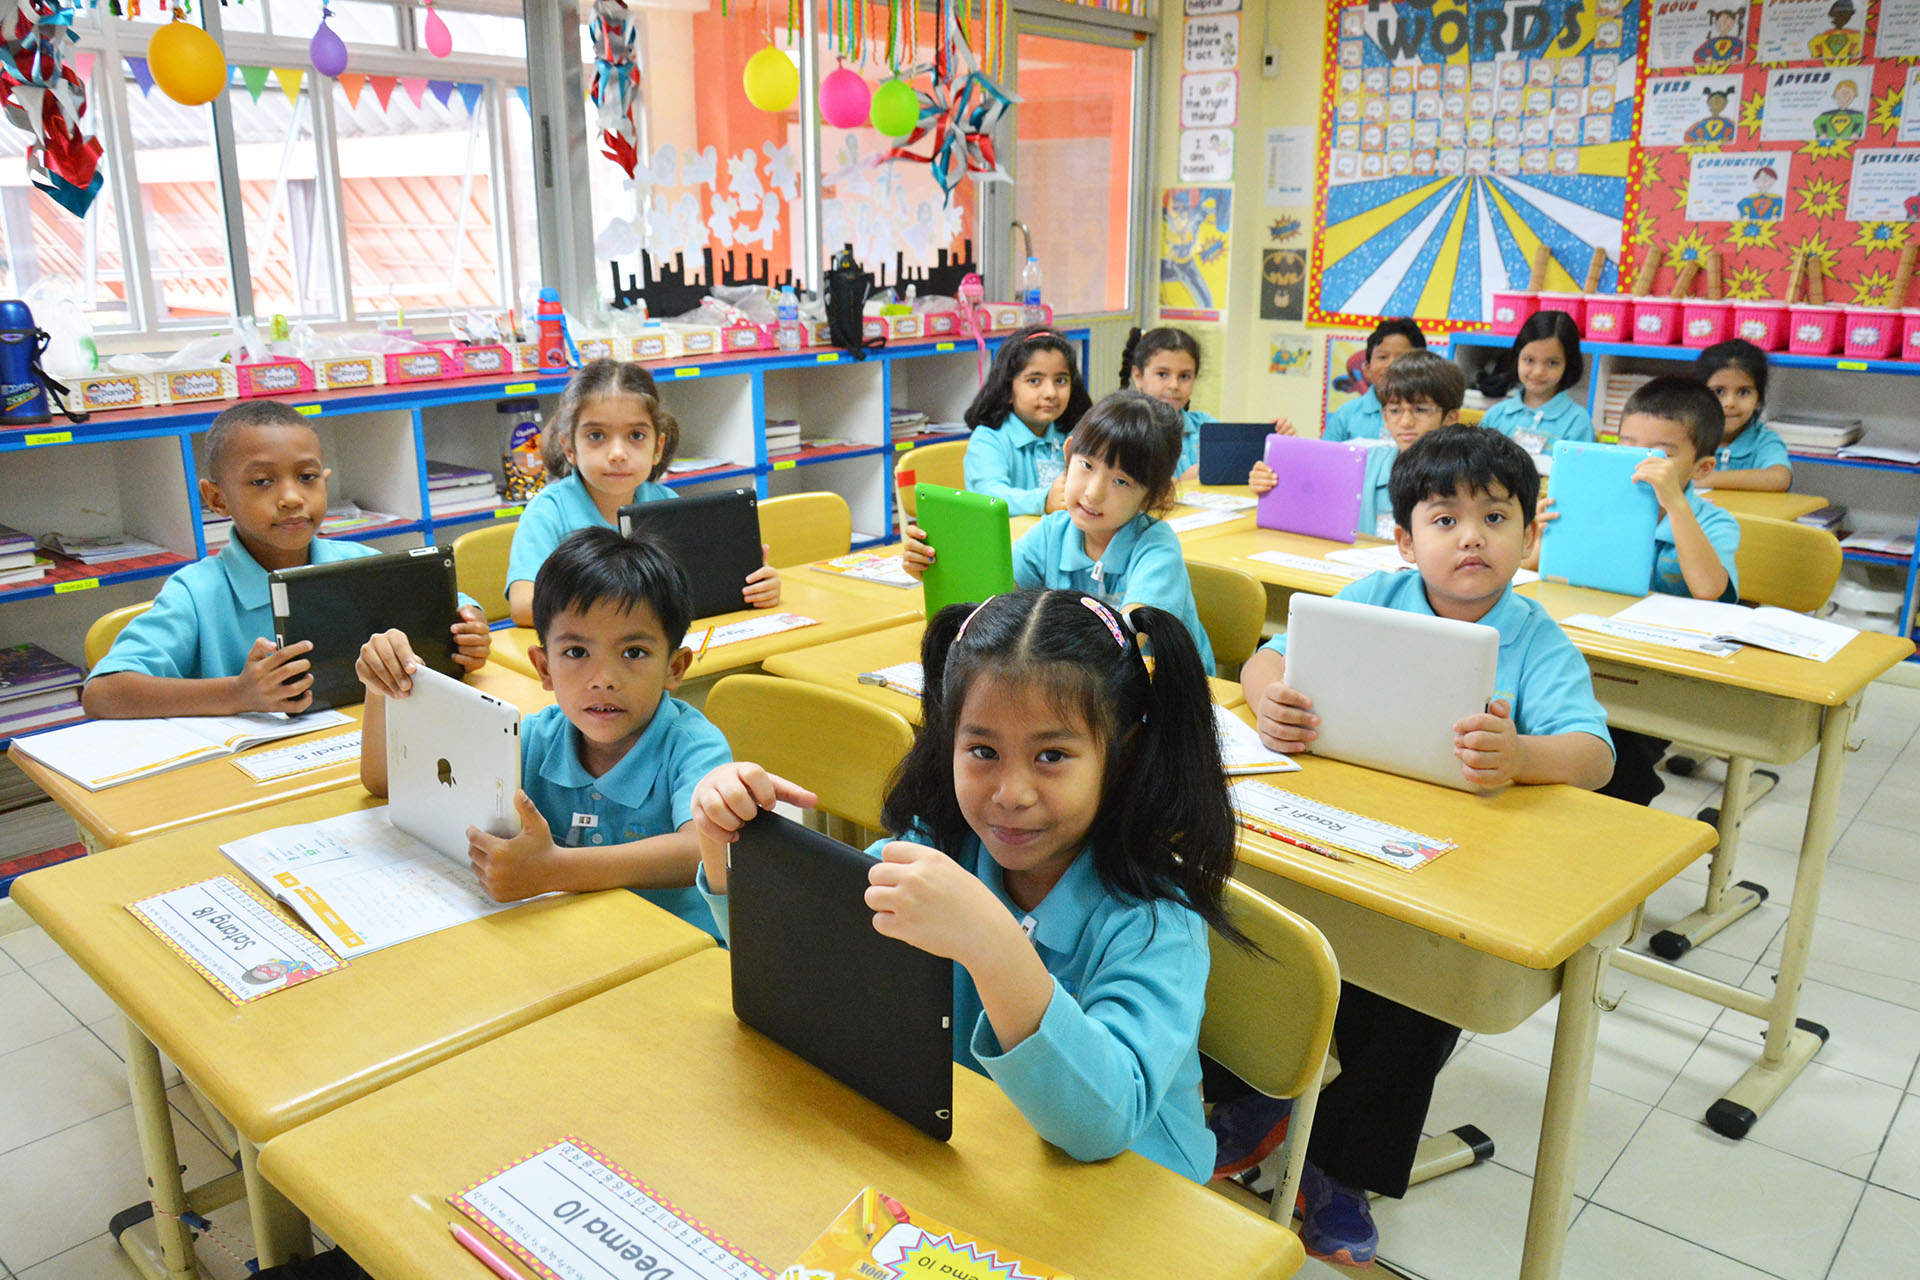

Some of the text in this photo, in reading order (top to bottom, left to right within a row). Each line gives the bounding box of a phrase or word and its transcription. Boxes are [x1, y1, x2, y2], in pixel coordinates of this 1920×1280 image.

[1188, 24, 1219, 35] I think
[1377, 2, 1585, 60] WORDS
[1187, 36, 1221, 47] before
[1187, 51, 1192, 61] I
[1774, 72, 1832, 87] ADVERB
[1200, 86, 1211, 96] do
[1653, 80, 1691, 96] VERB
[1185, 98, 1228, 110] the right
[1190, 154, 1204, 162] am
[1698, 157, 1776, 169] CONJUNCTION
[101, 388, 132, 397] Danish
[1294, 811, 1346, 832] Raafi
[192, 906, 256, 951] Satang 18
[553, 1200, 675, 1280] Deema 10
[918, 1256, 937, 1270] 10
